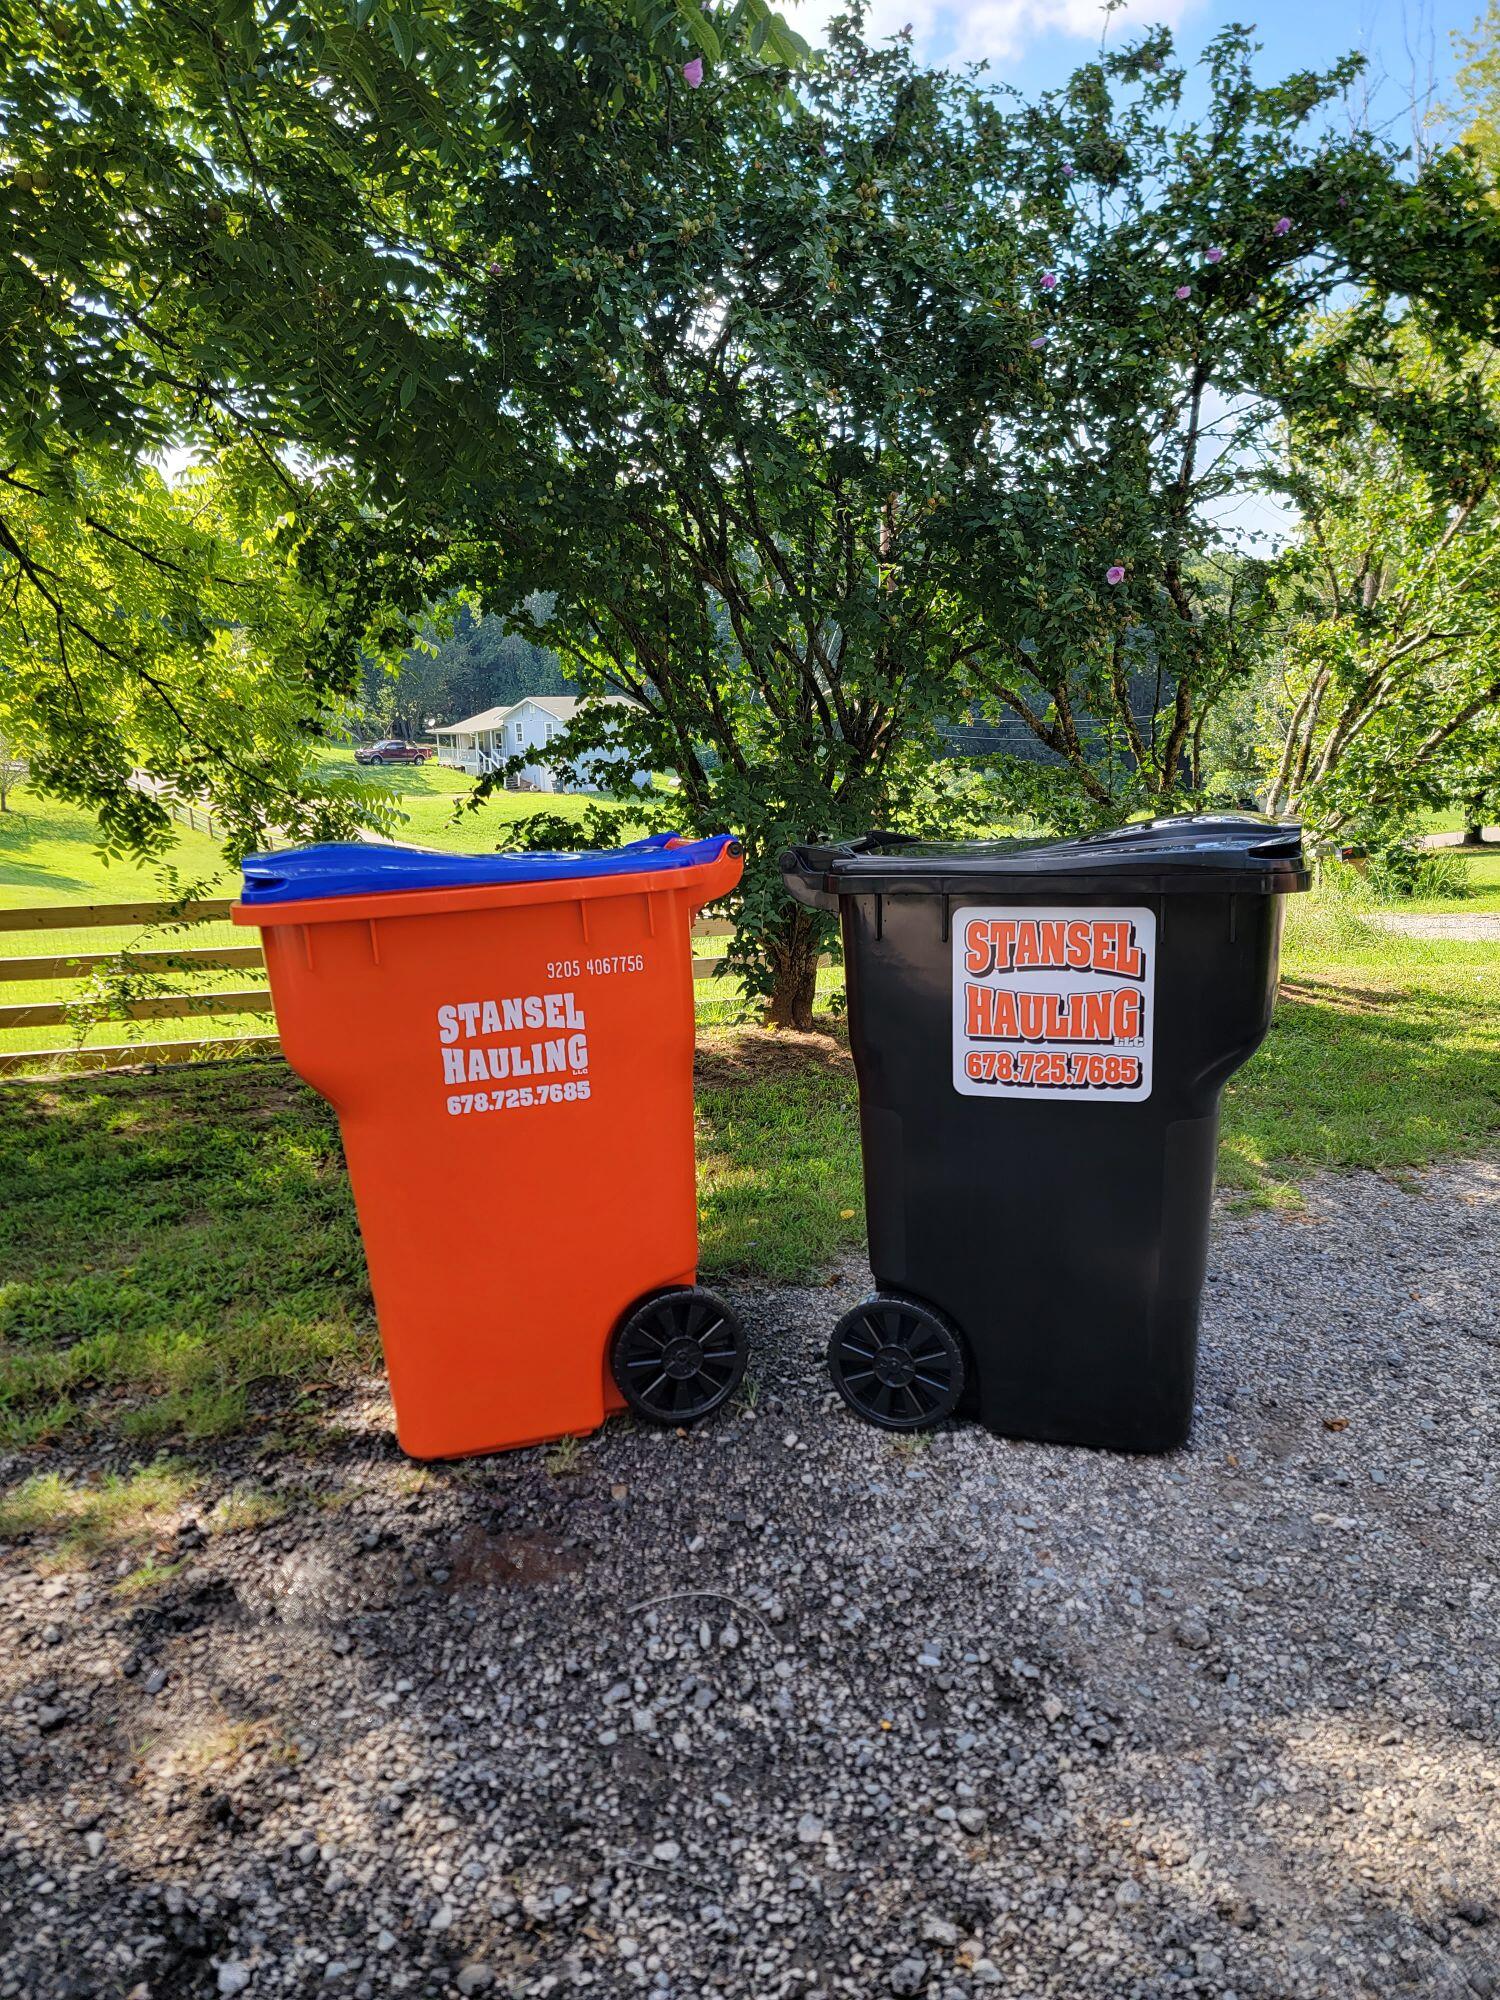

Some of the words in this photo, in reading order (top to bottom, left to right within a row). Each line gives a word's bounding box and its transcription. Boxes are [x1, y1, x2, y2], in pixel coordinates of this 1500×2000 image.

[547, 960, 580, 978] 9205
[586, 955, 644, 976] 4067756
[965, 919, 1145, 982] STANSEL
[437, 992, 586, 1044] STANSEL
[964, 982, 1145, 1045] HAULING
[441, 1033, 589, 1085] HAULING
[1113, 1036, 1144, 1047] LLC
[965, 1051, 1143, 1090] 678.725.7685
[447, 1080, 591, 1116] 678.725.7685
